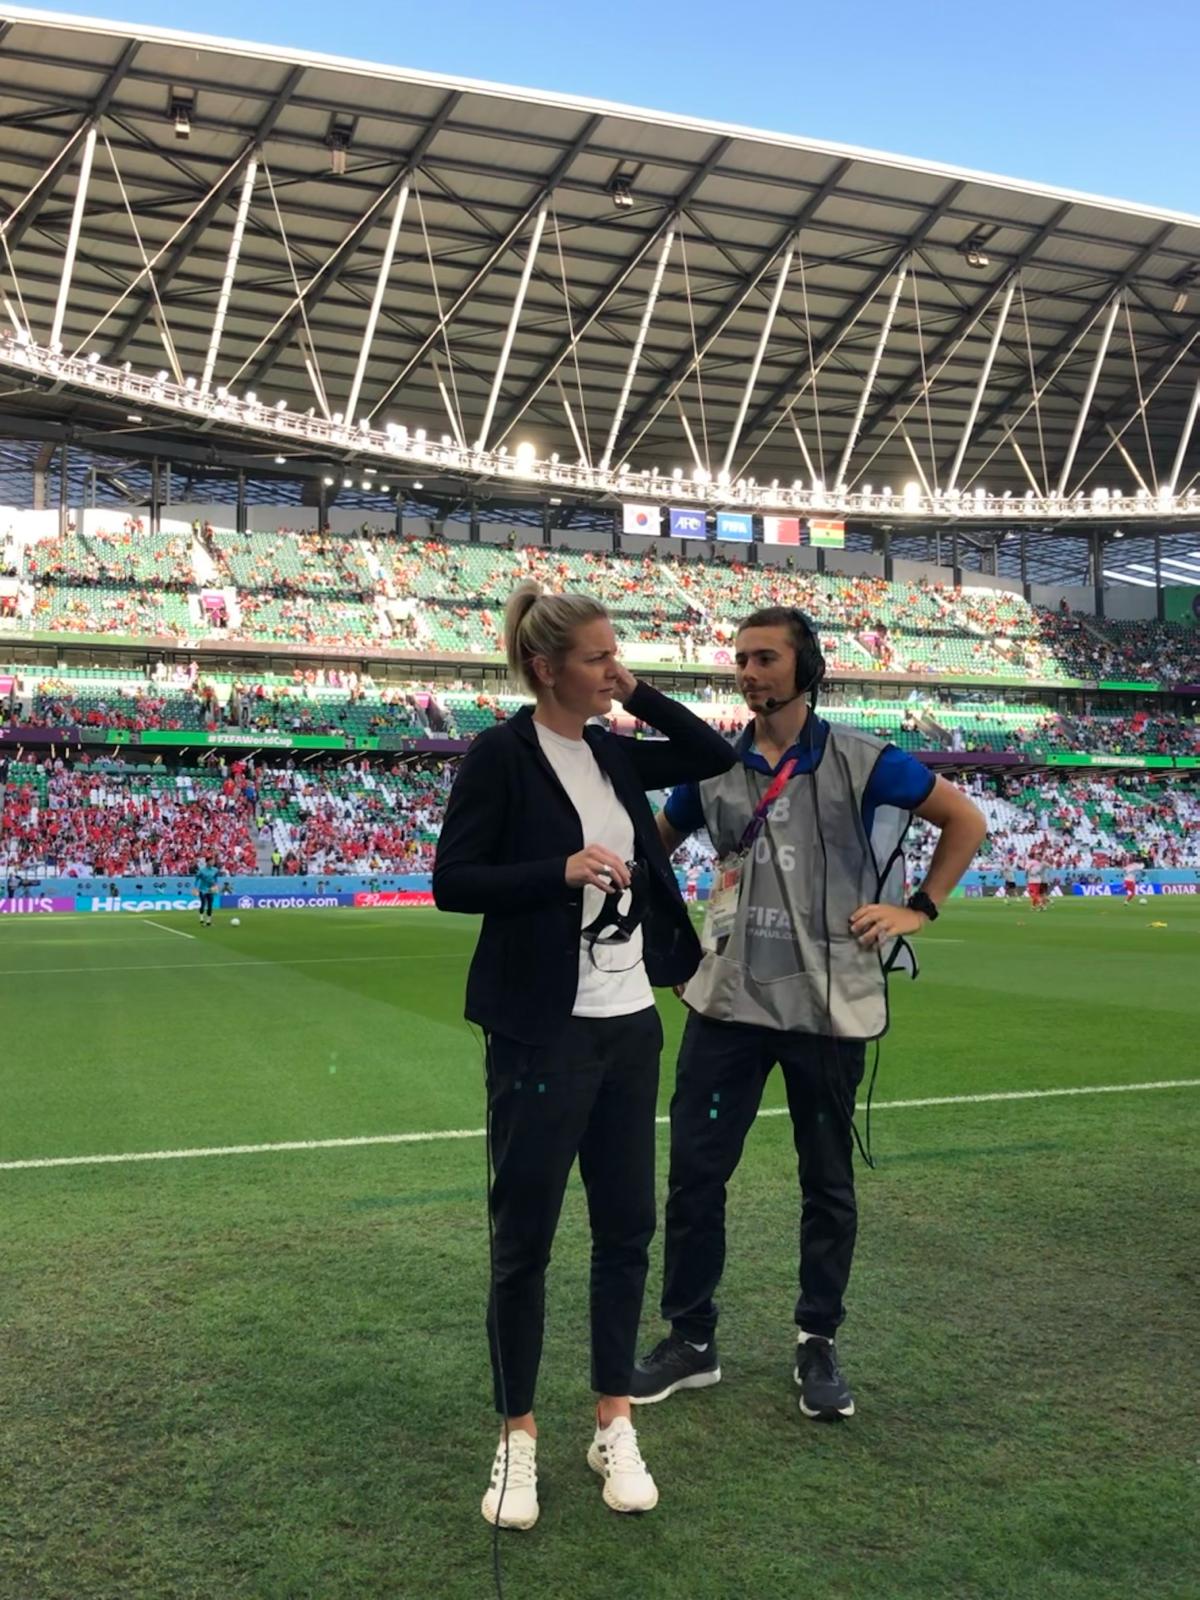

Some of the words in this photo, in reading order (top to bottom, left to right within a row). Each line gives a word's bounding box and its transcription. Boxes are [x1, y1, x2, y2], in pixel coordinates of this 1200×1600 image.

[674, 516, 702, 531] AFC
[208, 735, 293, 747] #FIFAWorldCup
[1081, 884, 1113, 896] VISA
[1127, 884, 1155, 896] ISA
[1161, 884, 1197, 895] QATAR
[91, 896, 201, 912] Hisense
[257, 896, 339, 909] crypto.com
